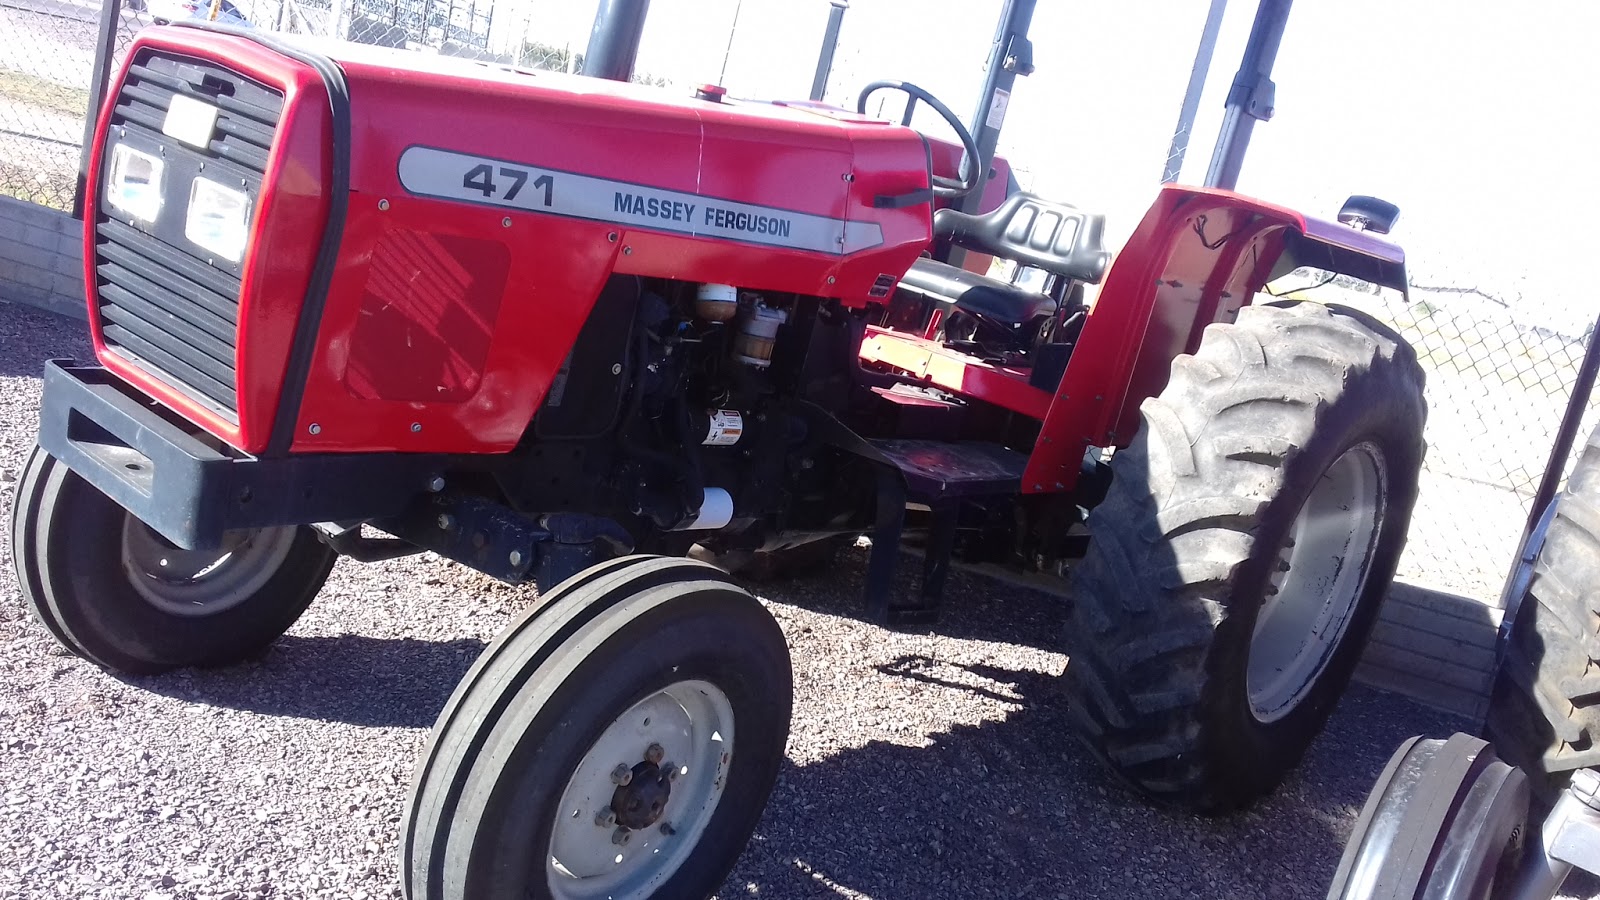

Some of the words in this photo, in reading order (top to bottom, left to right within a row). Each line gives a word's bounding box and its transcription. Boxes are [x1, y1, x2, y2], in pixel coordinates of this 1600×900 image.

[463, 164, 554, 207] 471
[614, 192, 696, 223] MASSEY
[704, 207, 791, 238] FERGUSON
